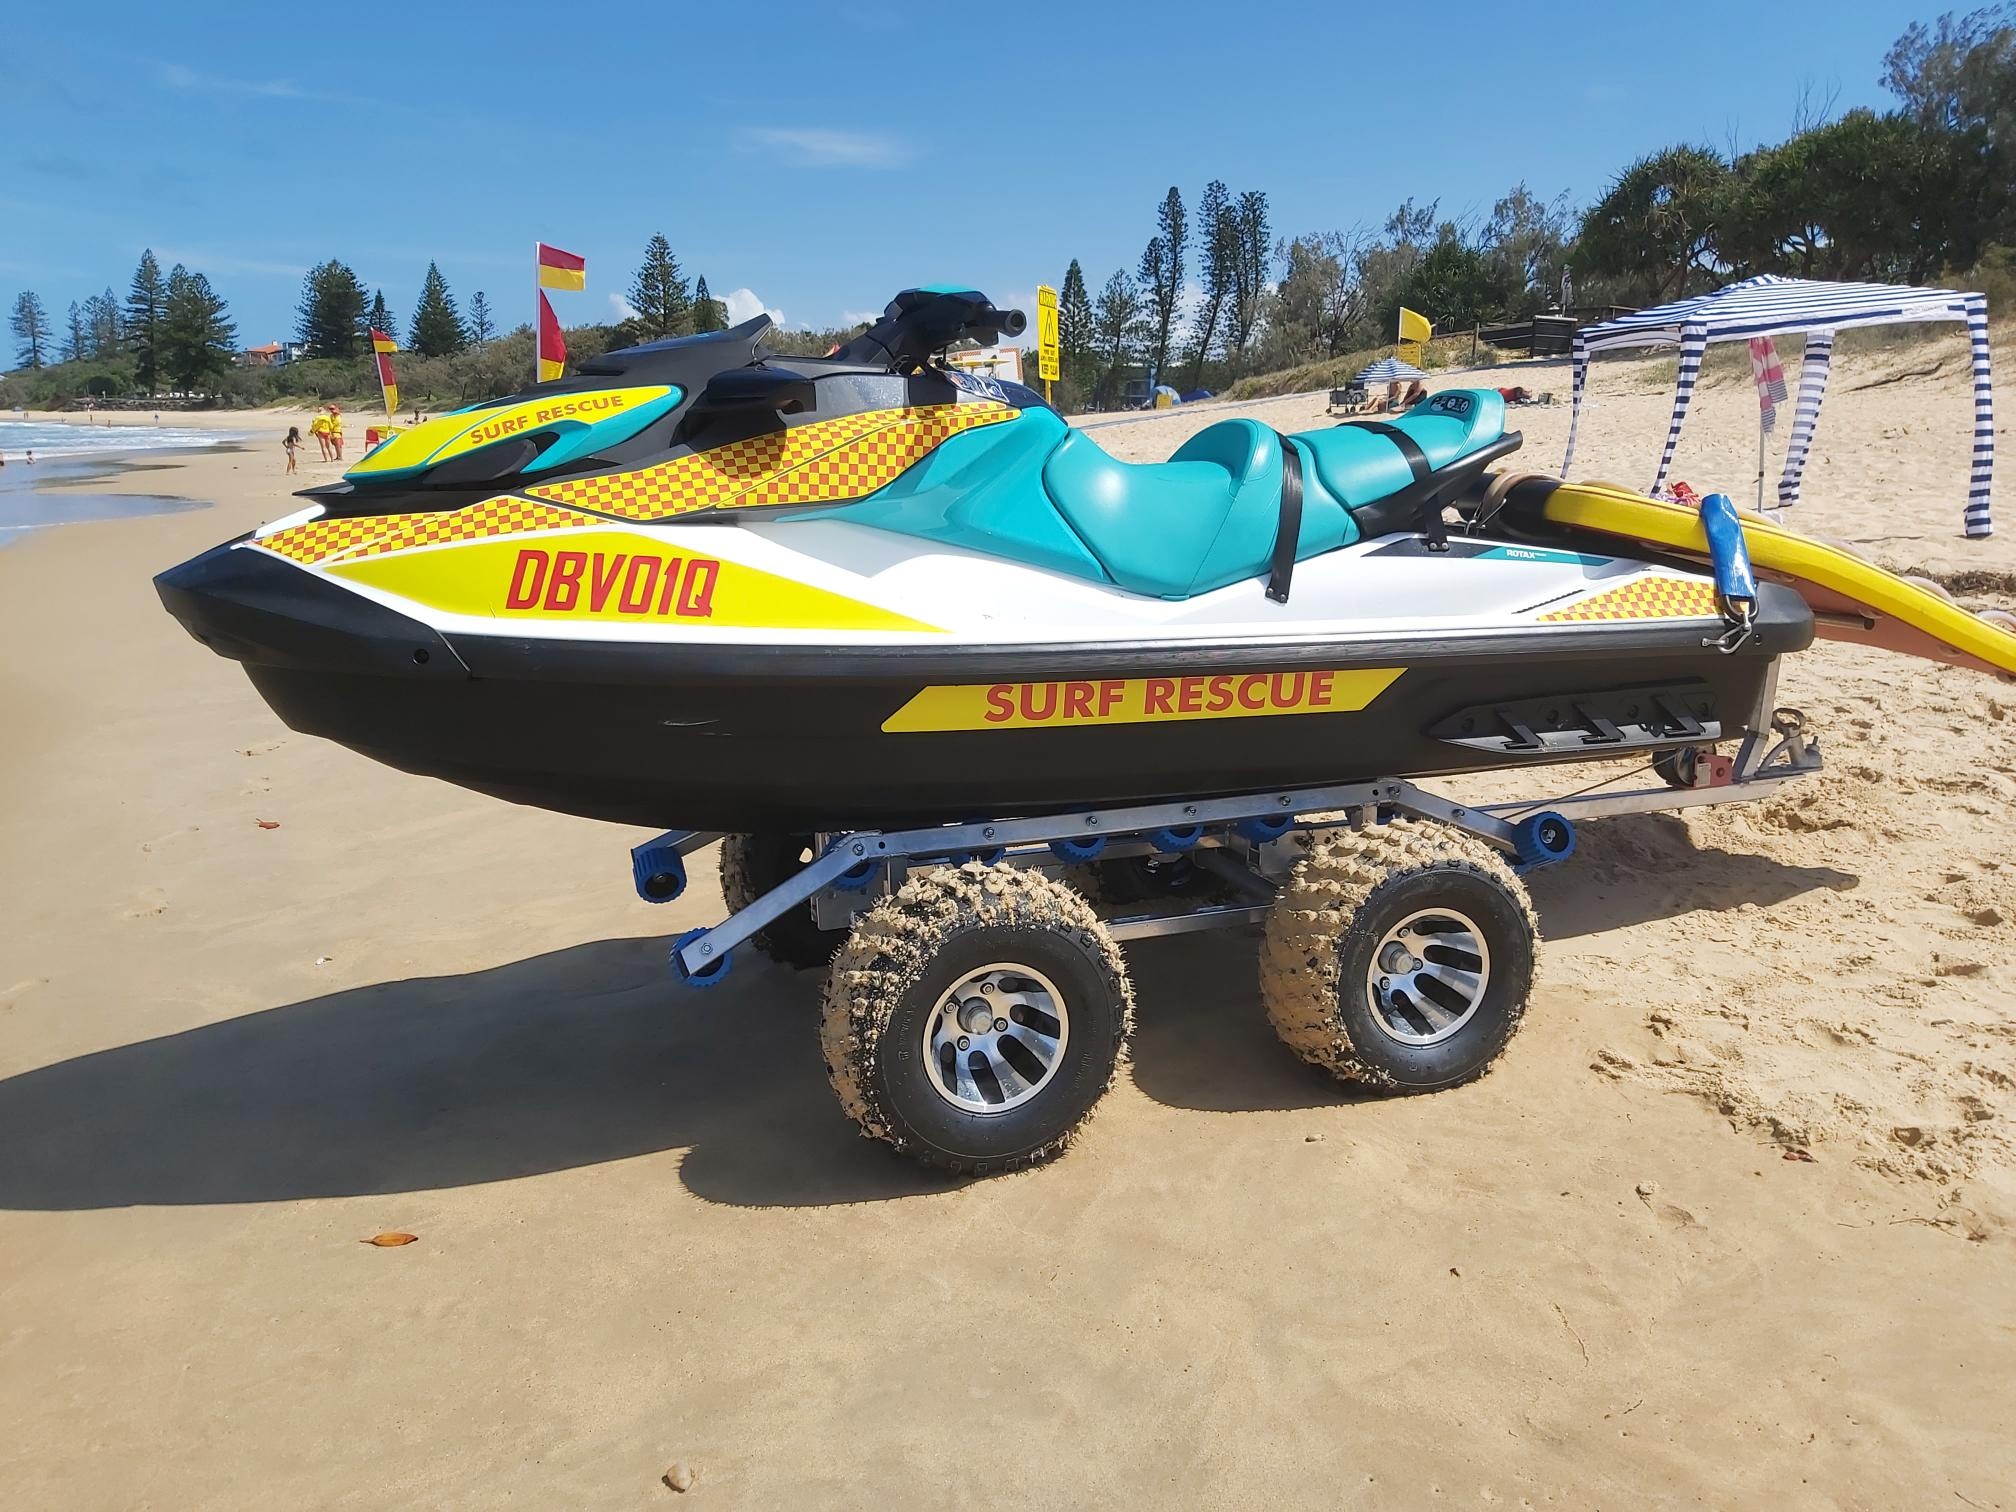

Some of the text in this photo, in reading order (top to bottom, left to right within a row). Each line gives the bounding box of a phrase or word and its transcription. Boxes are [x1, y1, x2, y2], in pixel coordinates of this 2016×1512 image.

[470, 395, 624, 444] SURF RESCUE
[1506, 549, 1535, 560] ROTAX
[984, 671, 1335, 723] SURF RESCUE
